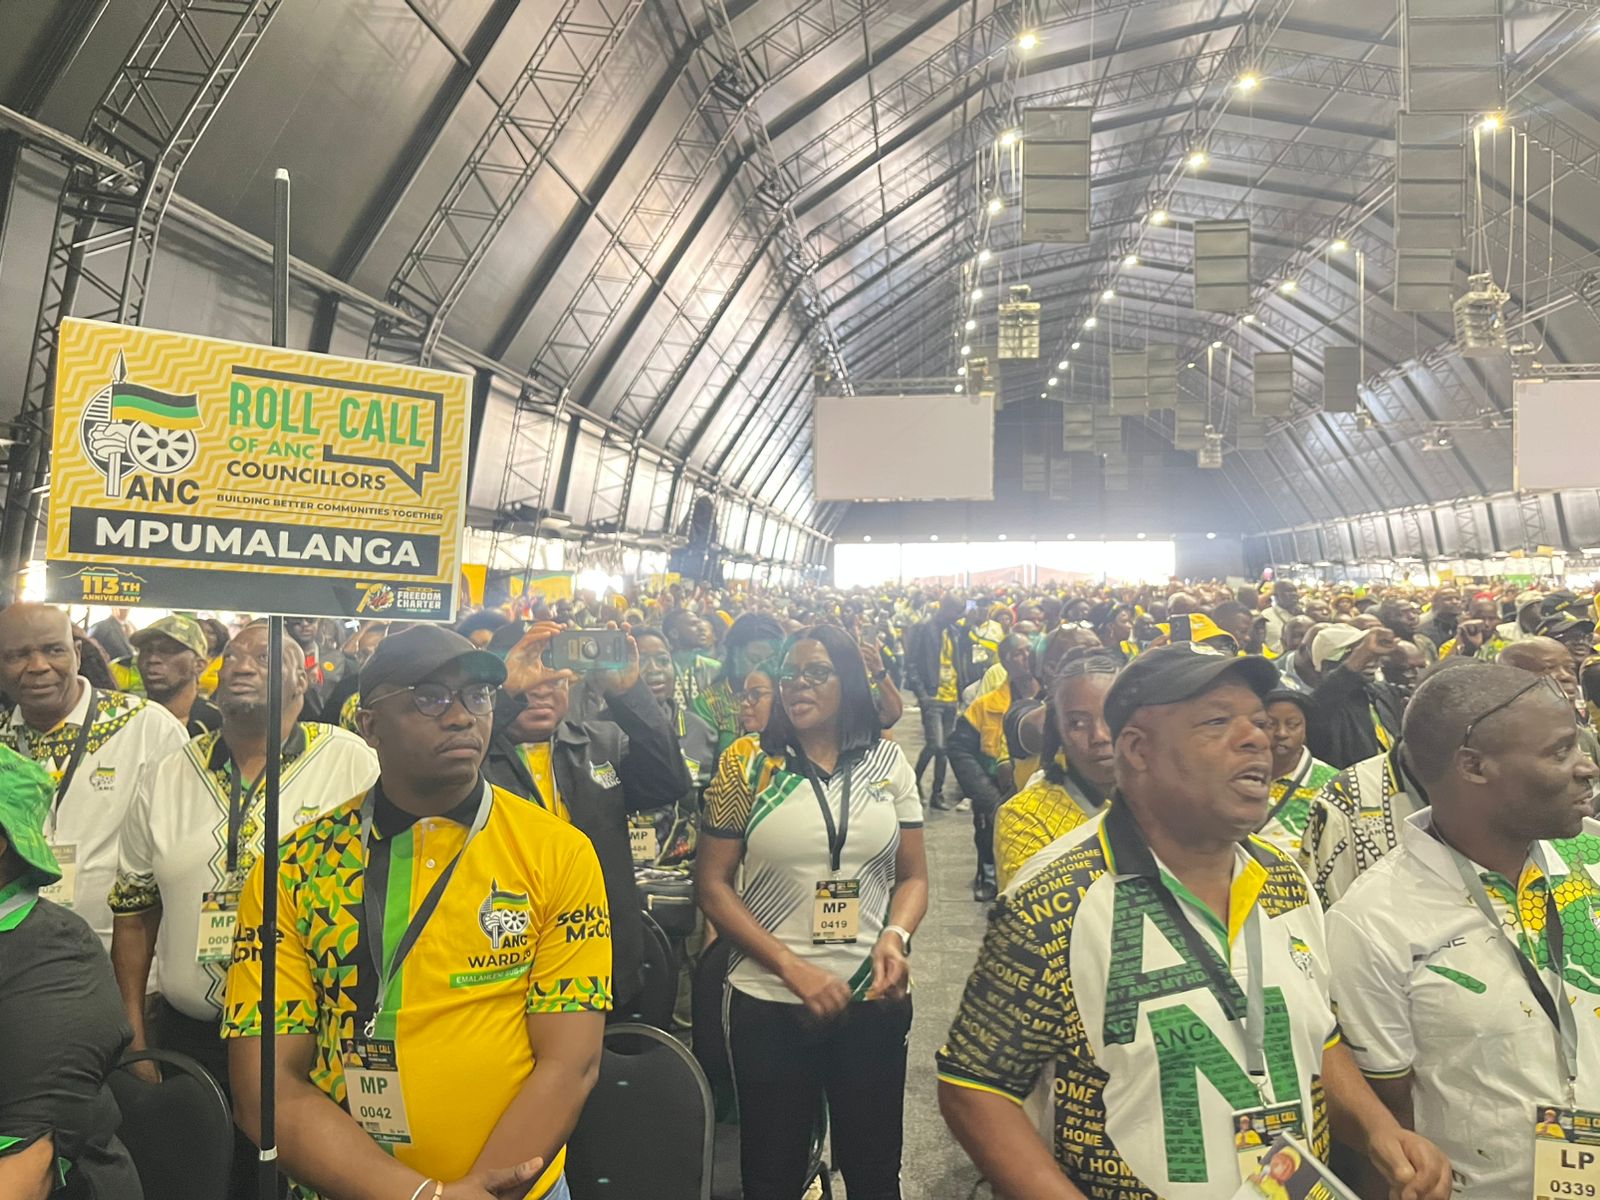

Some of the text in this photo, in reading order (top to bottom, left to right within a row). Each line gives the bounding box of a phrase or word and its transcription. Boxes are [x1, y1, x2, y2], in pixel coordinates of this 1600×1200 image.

[228, 381, 427, 448] ROLL CALL
[228, 436, 315, 460] OF ANC
[226, 460, 387, 491] COUNCILLORS
[125, 475, 201, 507] ANC
[216, 493, 443, 521] BUILDING BETTER COMMUNITIES TOGETHER
[95, 516, 421, 567] MPUMALANGA
[82, 594, 141, 603] ANNIVERSARY
[396, 599, 441, 610] CHARTER
[397, 590, 442, 601] FREEDOM
[630, 831, 649, 841] MP
[1069, 848, 1102, 862] HOME
[1059, 859, 1094, 874] HOME
[1027, 874, 1076, 902] HOME
[823, 901, 847, 914] MP
[1017, 891, 1074, 926] ANC
[211, 915, 236, 928] MP
[820, 920, 848, 929] 0419
[1050, 916, 1074, 935] MY
[502, 934, 528, 949] ANC
[468, 950, 520, 969] WARD
[360, 1076, 388, 1094] MP
[1054, 1077, 1097, 1103] OME
[360, 1105, 392, 1119] 0042
[1062, 1127, 1103, 1147] HOME
[1089, 1157, 1134, 1177] HOM
[1561, 1149, 1595, 1170] LP
[1550, 1179, 1596, 1197] 0339
